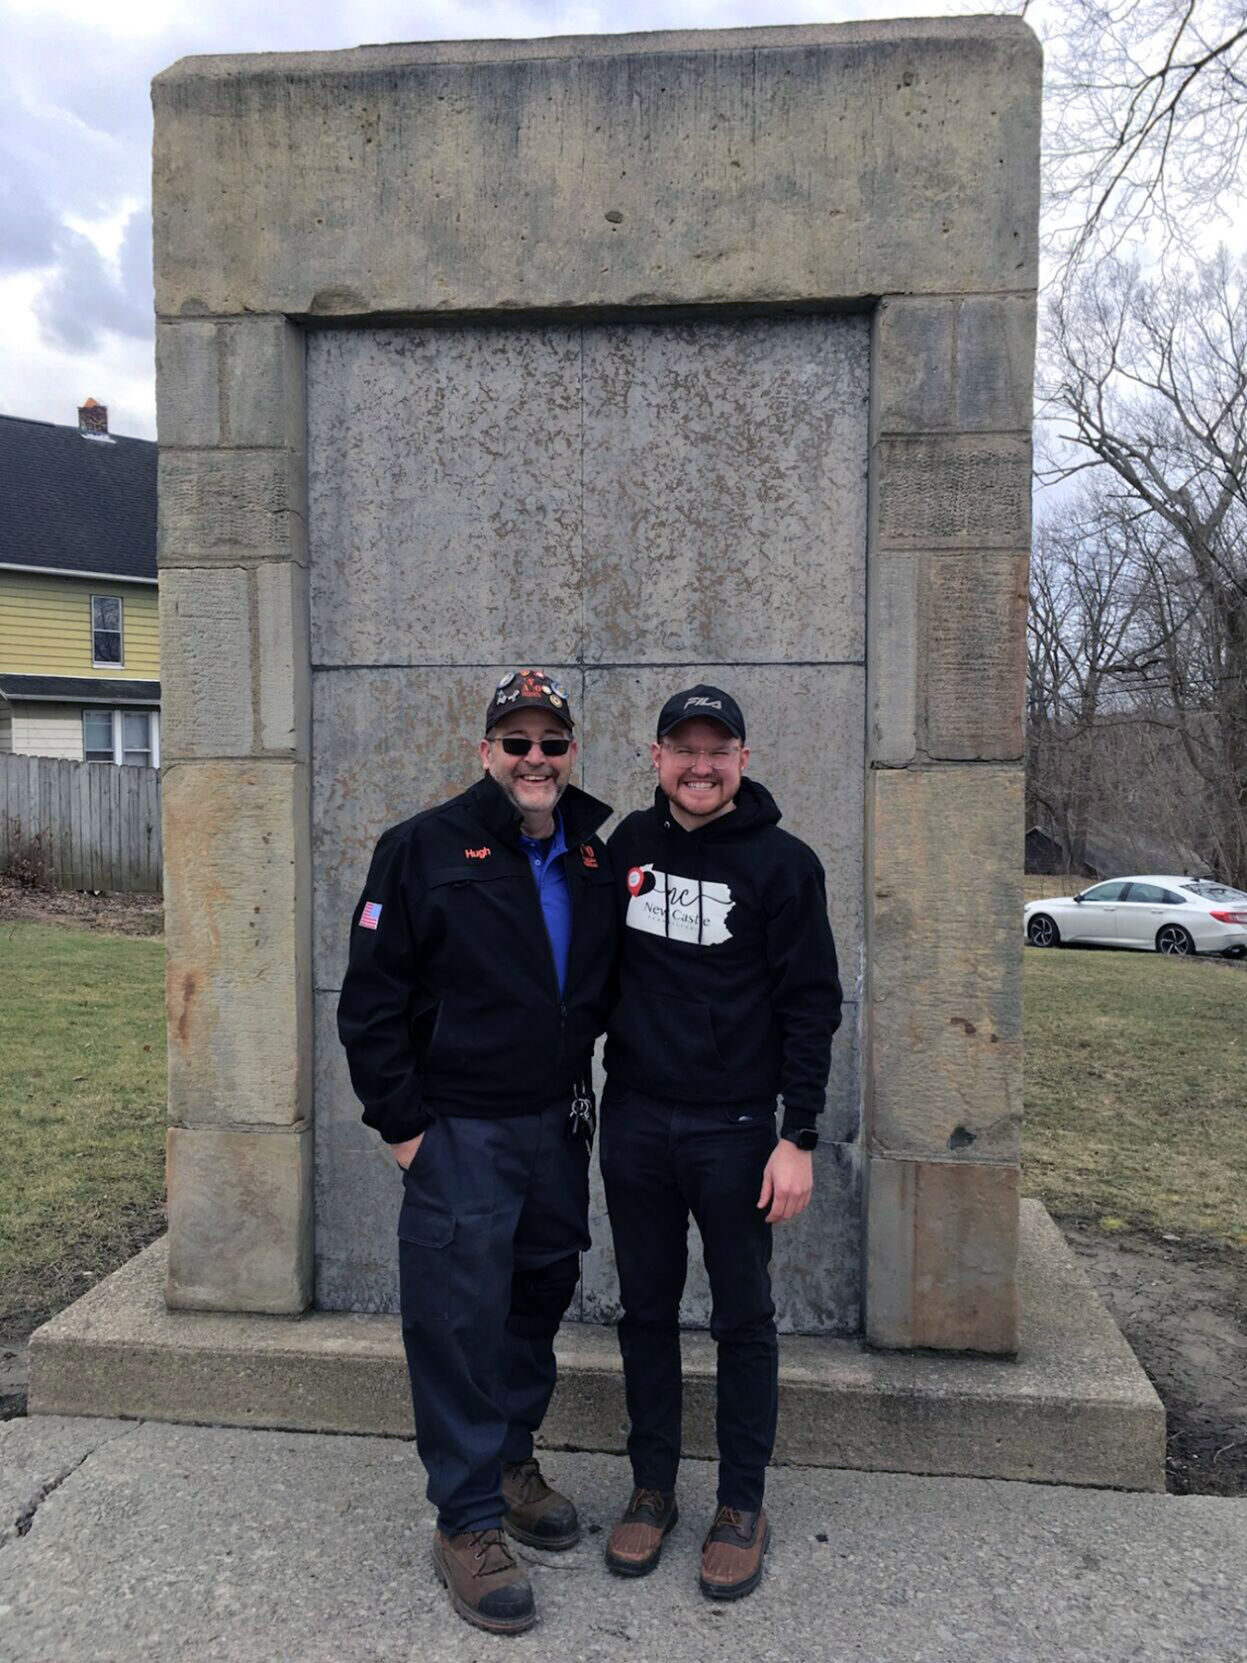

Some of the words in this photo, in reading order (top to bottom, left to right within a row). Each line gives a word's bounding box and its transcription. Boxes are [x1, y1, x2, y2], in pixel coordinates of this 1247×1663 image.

[683, 697, 722, 710] FILA
[464, 846, 491, 859] Hugh
[672, 909, 711, 927] Caste
